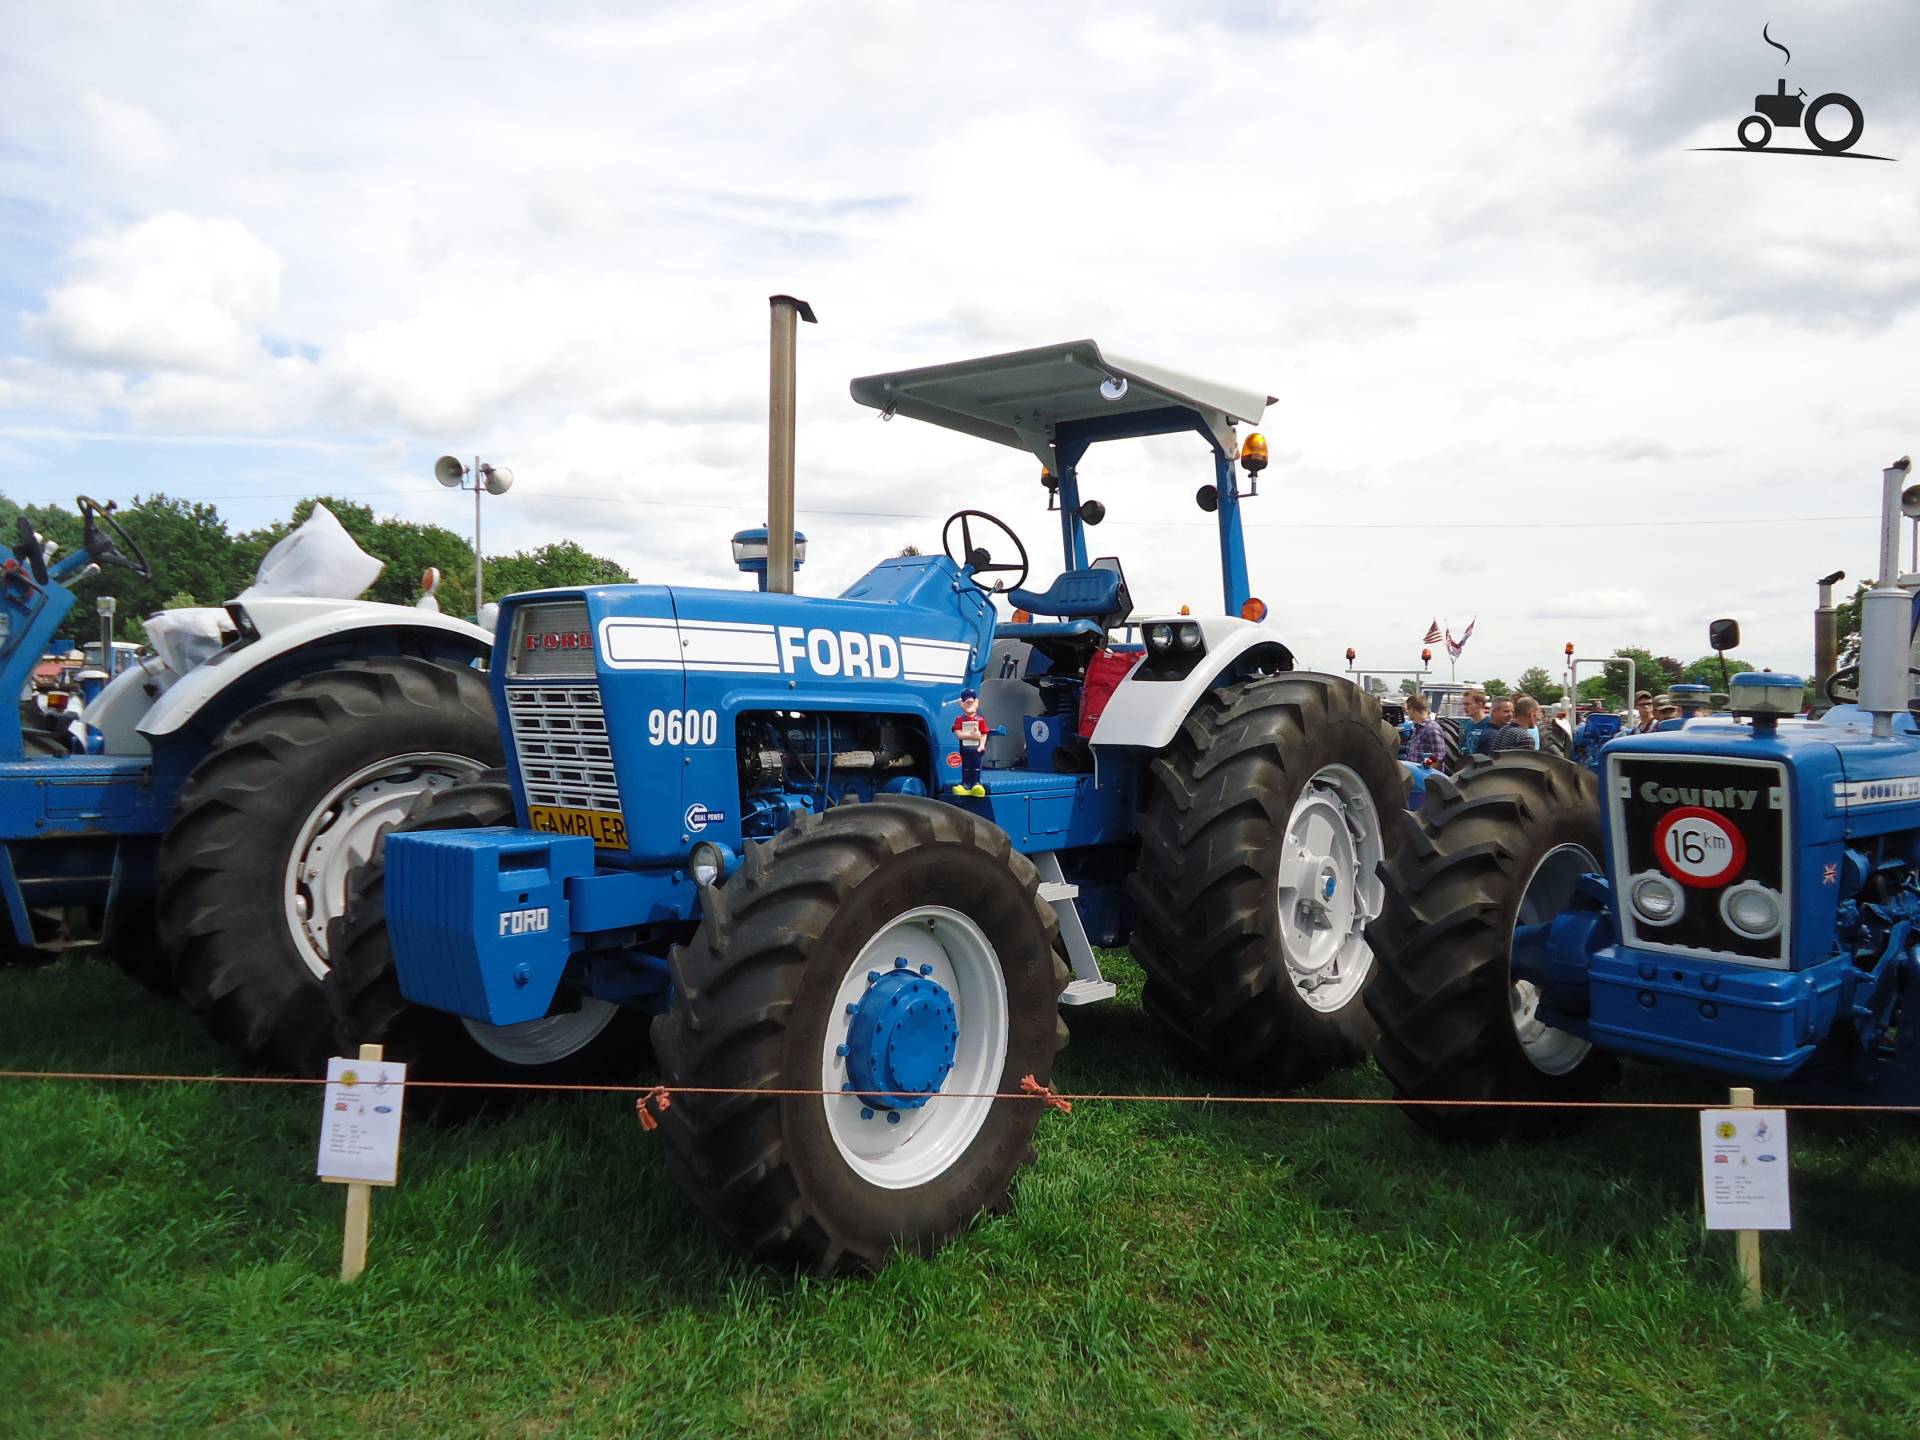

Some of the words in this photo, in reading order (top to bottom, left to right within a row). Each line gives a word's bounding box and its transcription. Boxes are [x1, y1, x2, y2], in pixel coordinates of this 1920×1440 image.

[526, 631, 593, 650] FORD
[778, 625, 900, 679] FORD
[648, 708, 717, 747] 9600
[1639, 781, 1758, 811] County
[533, 810, 629, 845] GAMBLER
[693, 814, 707, 822] DUAL
[708, 813, 724, 821] POWER
[1671, 829, 1705, 864] 16
[1704, 831, 1727, 850] km
[498, 908, 549, 936] FORD
